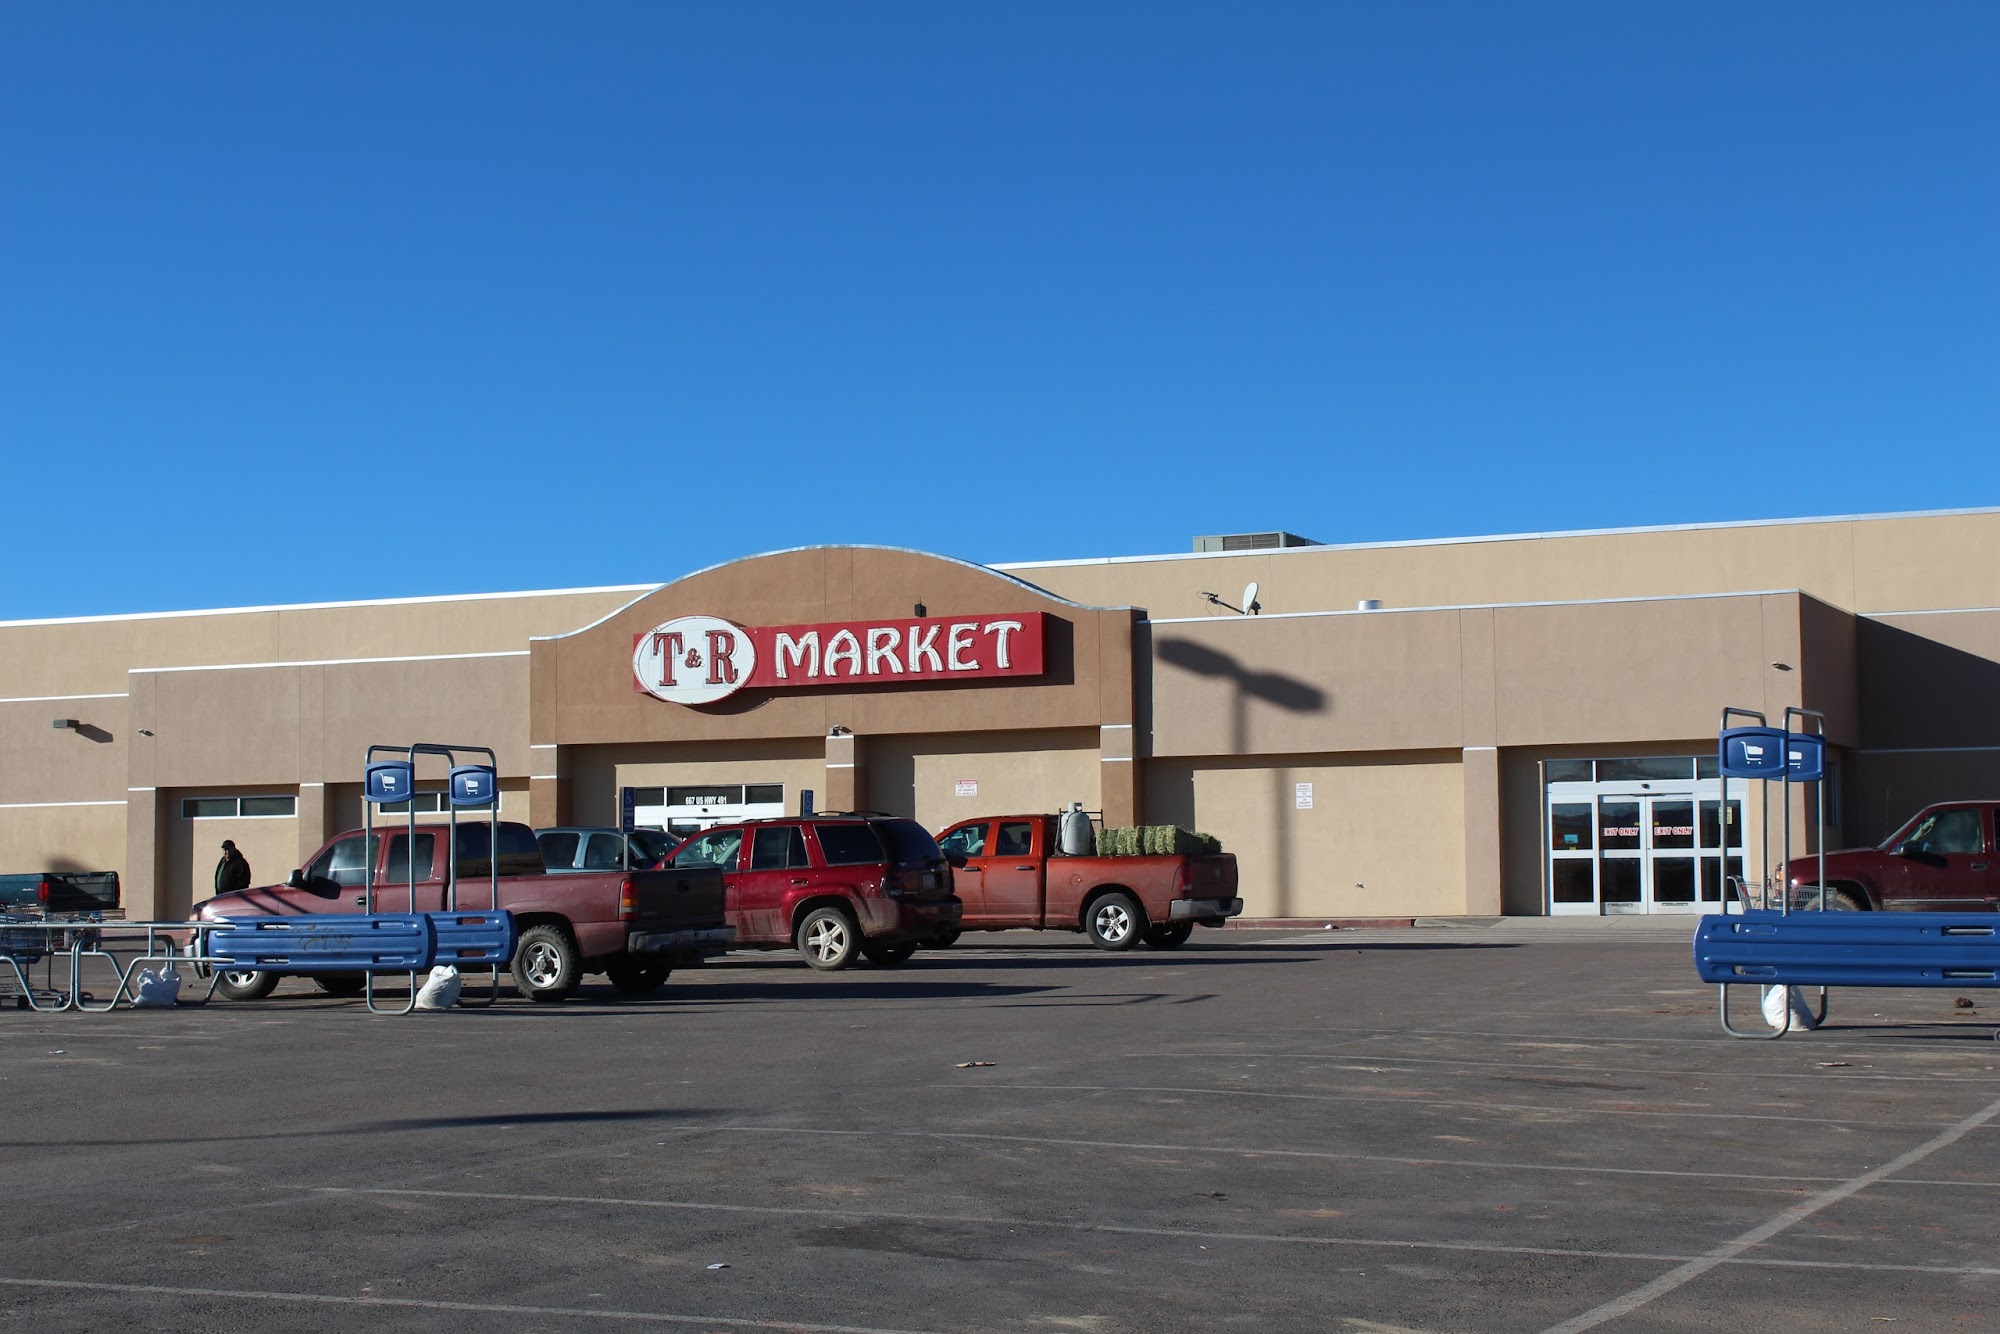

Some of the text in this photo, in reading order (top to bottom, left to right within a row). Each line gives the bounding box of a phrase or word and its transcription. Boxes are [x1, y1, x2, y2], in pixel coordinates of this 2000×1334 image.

[653, 620, 1023, 686] T&R MARKET
[685, 795, 727, 805] 667 US HWY 491
[1618, 827, 1639, 836] ONLY
[1654, 826, 1693, 836] EXIT ONLY
